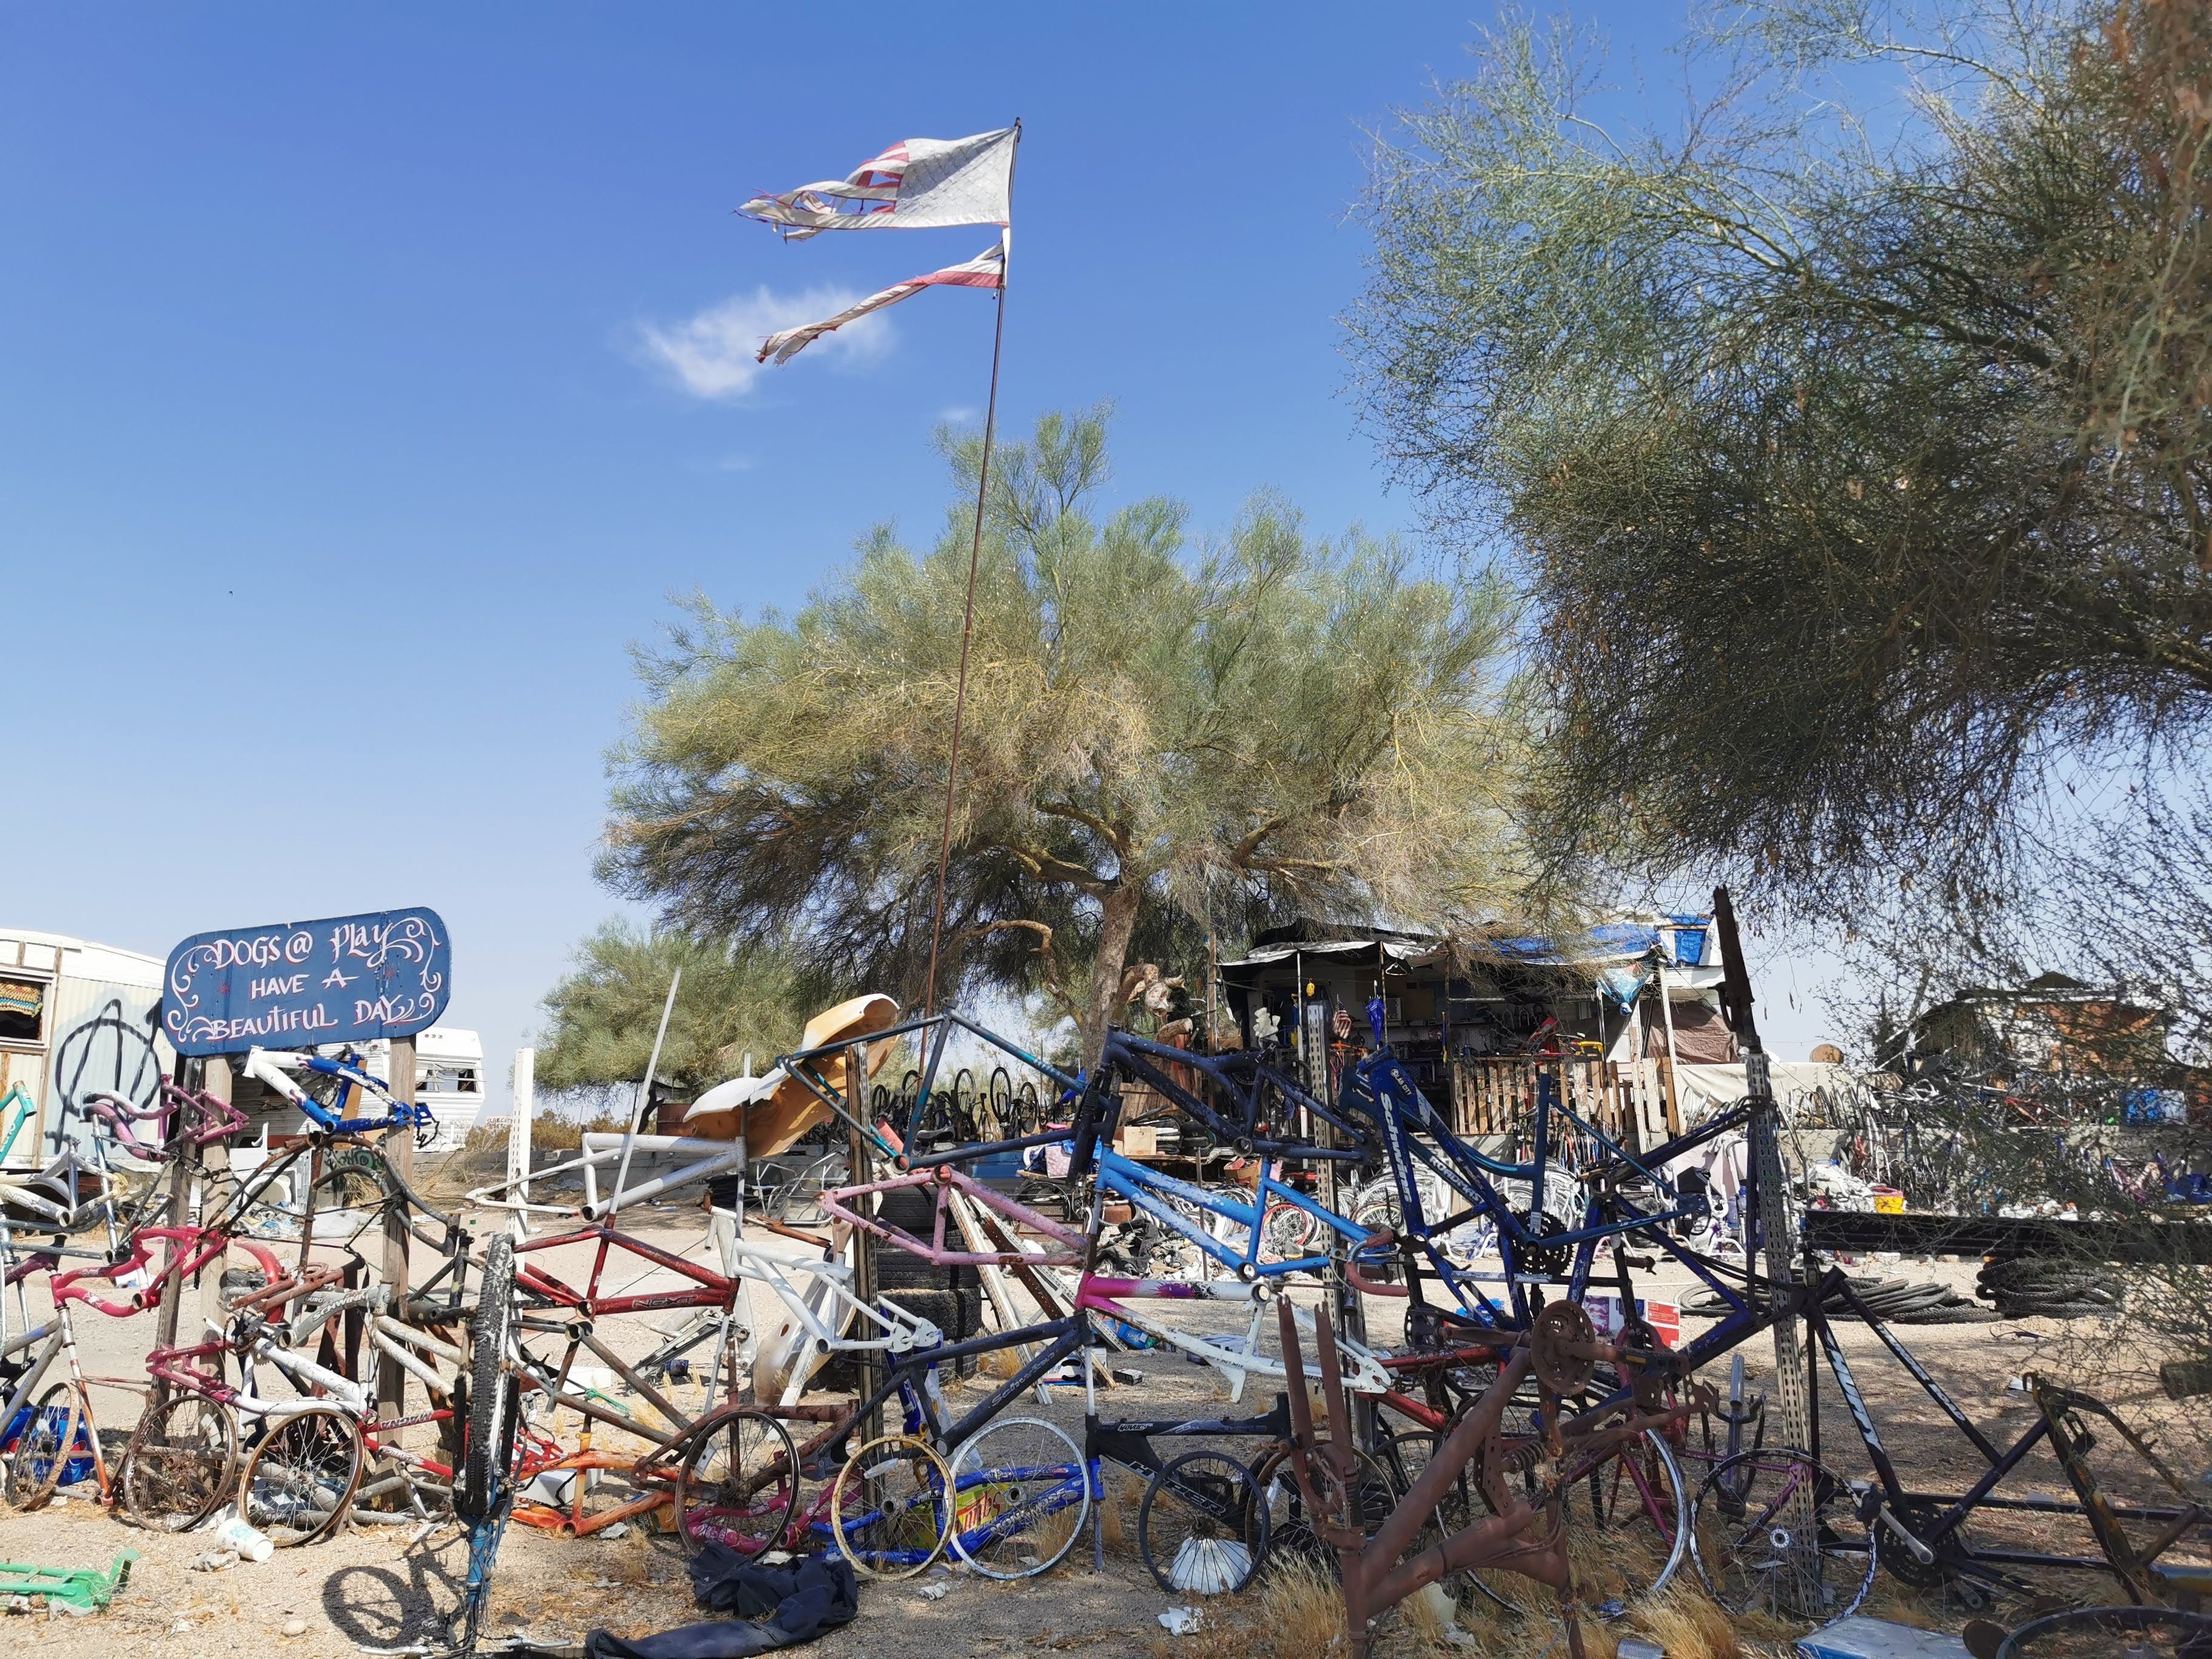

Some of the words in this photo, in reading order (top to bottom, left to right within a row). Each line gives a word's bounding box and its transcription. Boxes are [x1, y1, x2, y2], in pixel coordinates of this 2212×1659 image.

[213, 935, 281, 969] DOGS
[285, 931, 313, 963] @
[250, 974, 309, 999] HAVE
[321, 967, 360, 989] A
[353, 994, 404, 1025] DAY
[380, 1409, 434, 1430] MAGNA
[988, 1486, 1067, 1534] MONOSE
